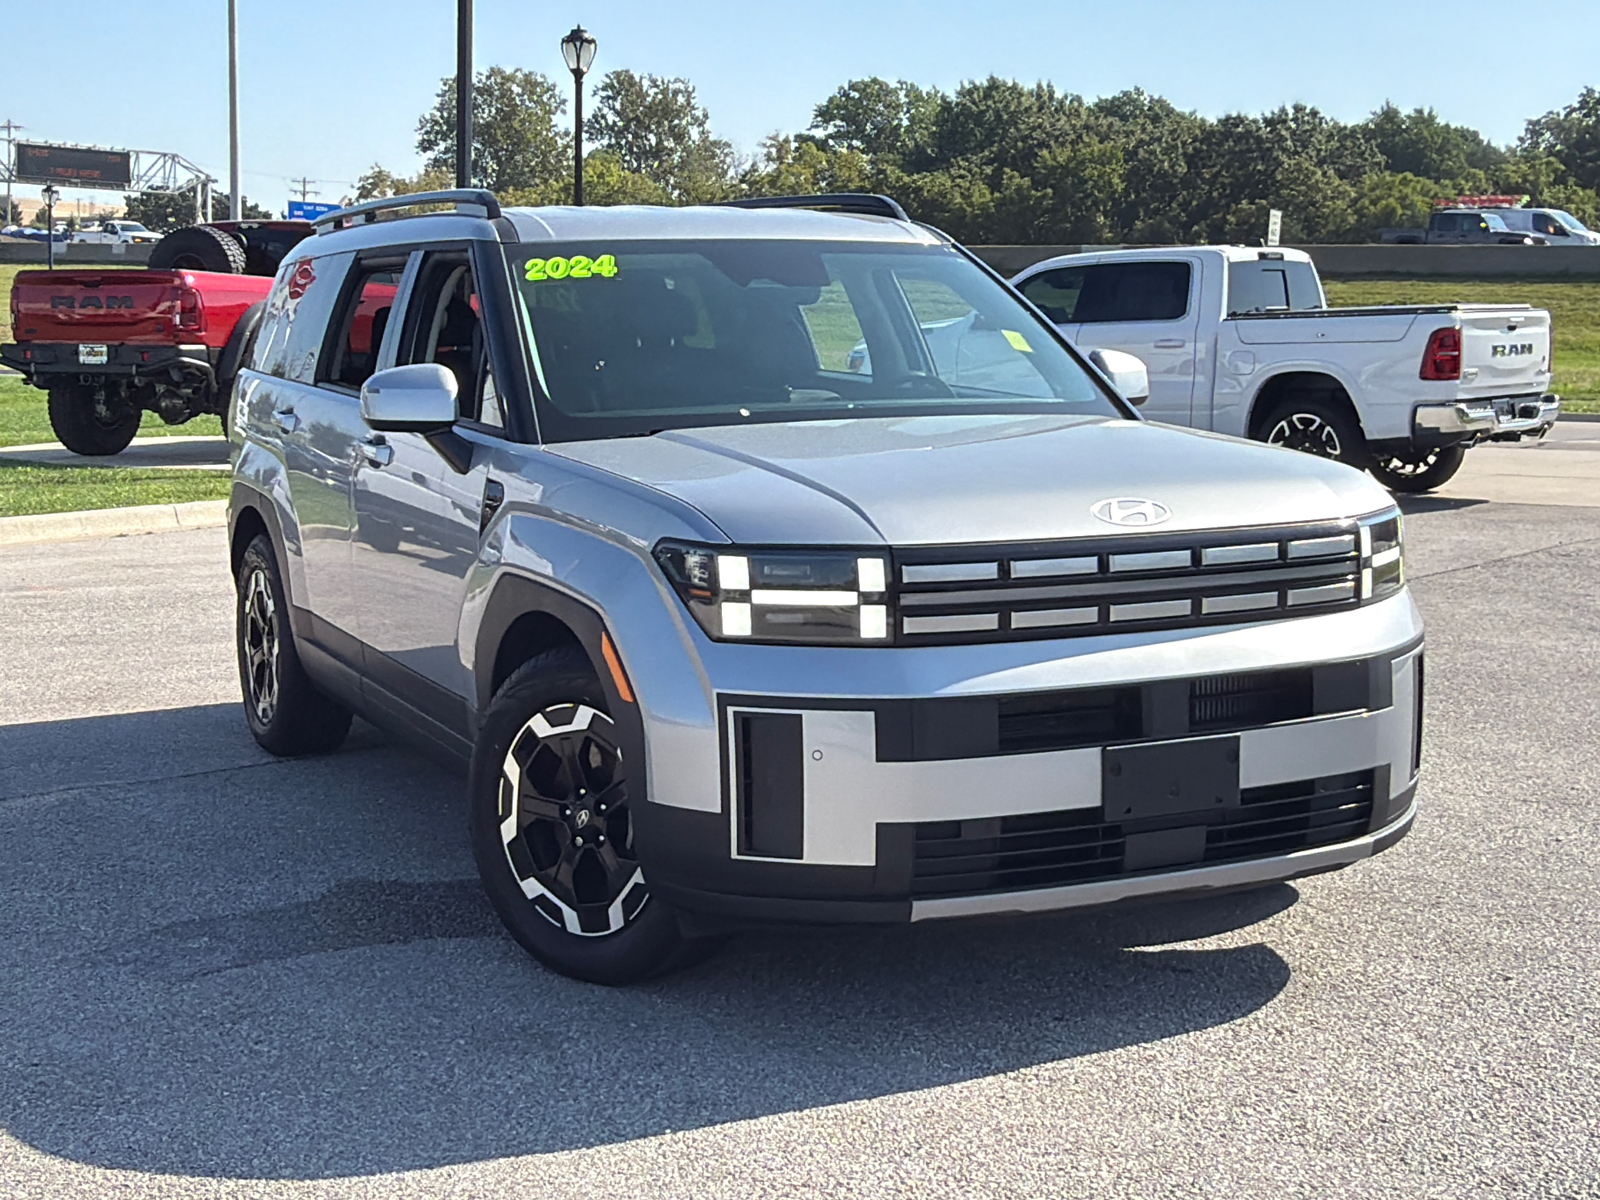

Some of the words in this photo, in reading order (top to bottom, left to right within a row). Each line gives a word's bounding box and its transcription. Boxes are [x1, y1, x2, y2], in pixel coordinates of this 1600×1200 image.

[524, 254, 618, 281] 2024
[51, 295, 135, 309] RAM
[1491, 343, 1533, 358] RAM
